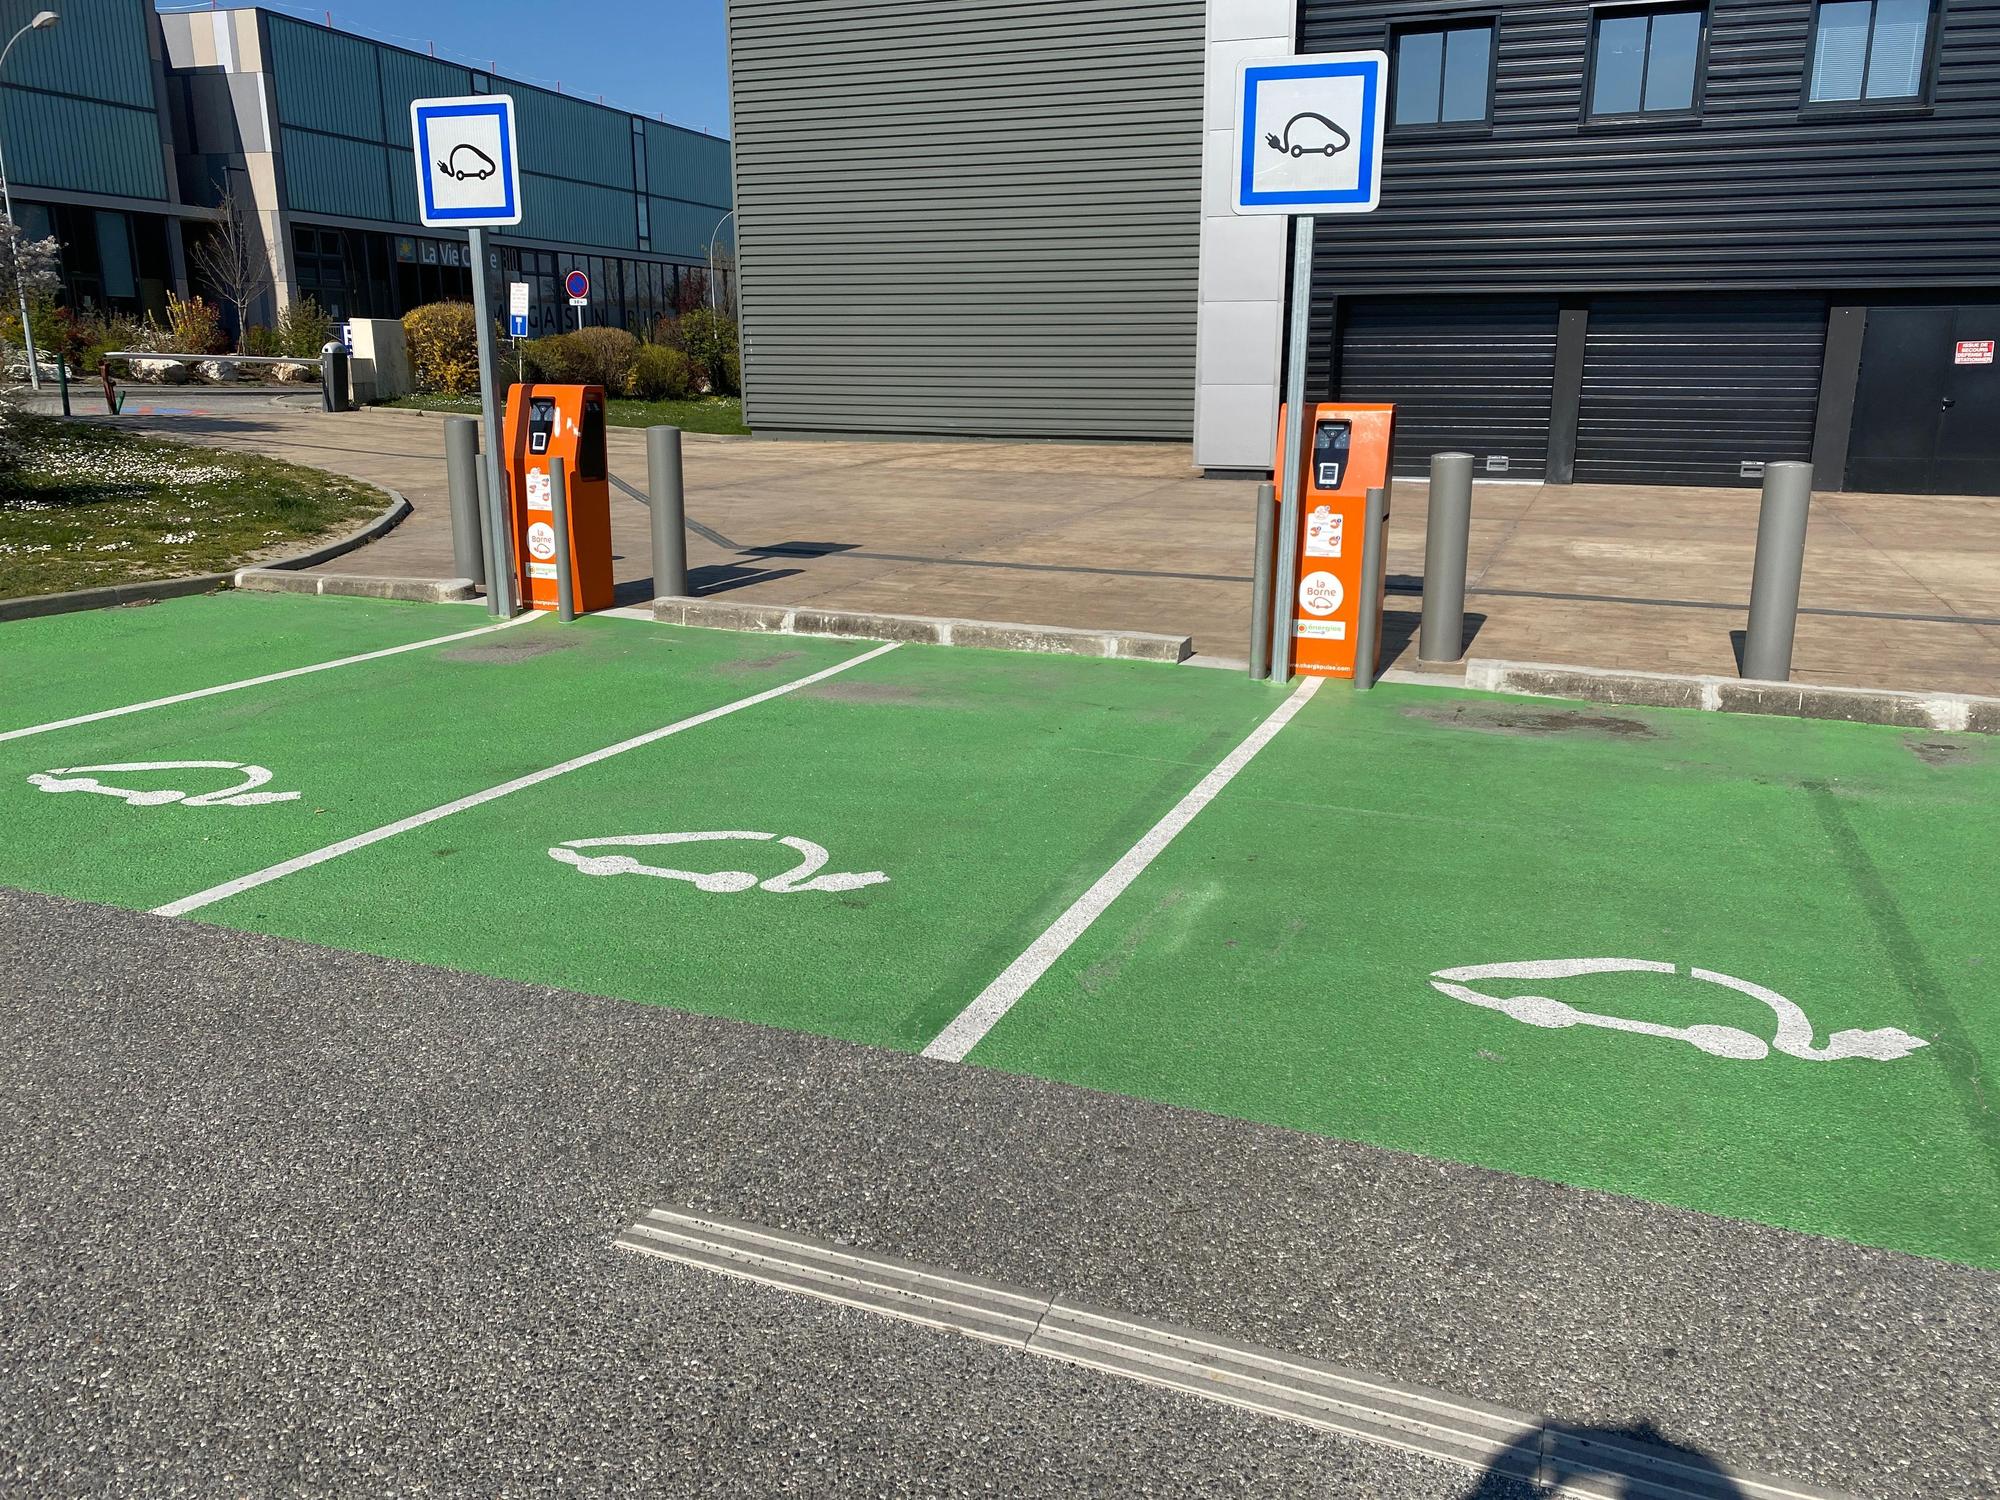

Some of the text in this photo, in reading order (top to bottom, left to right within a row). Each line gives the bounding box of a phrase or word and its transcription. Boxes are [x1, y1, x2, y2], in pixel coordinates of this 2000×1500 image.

[422, 242, 437, 263] La
[439, 243, 459, 266] Vie
[531, 535, 552, 544] Borne
[1316, 578, 1326, 588] la
[1307, 587, 1337, 597] Borne
